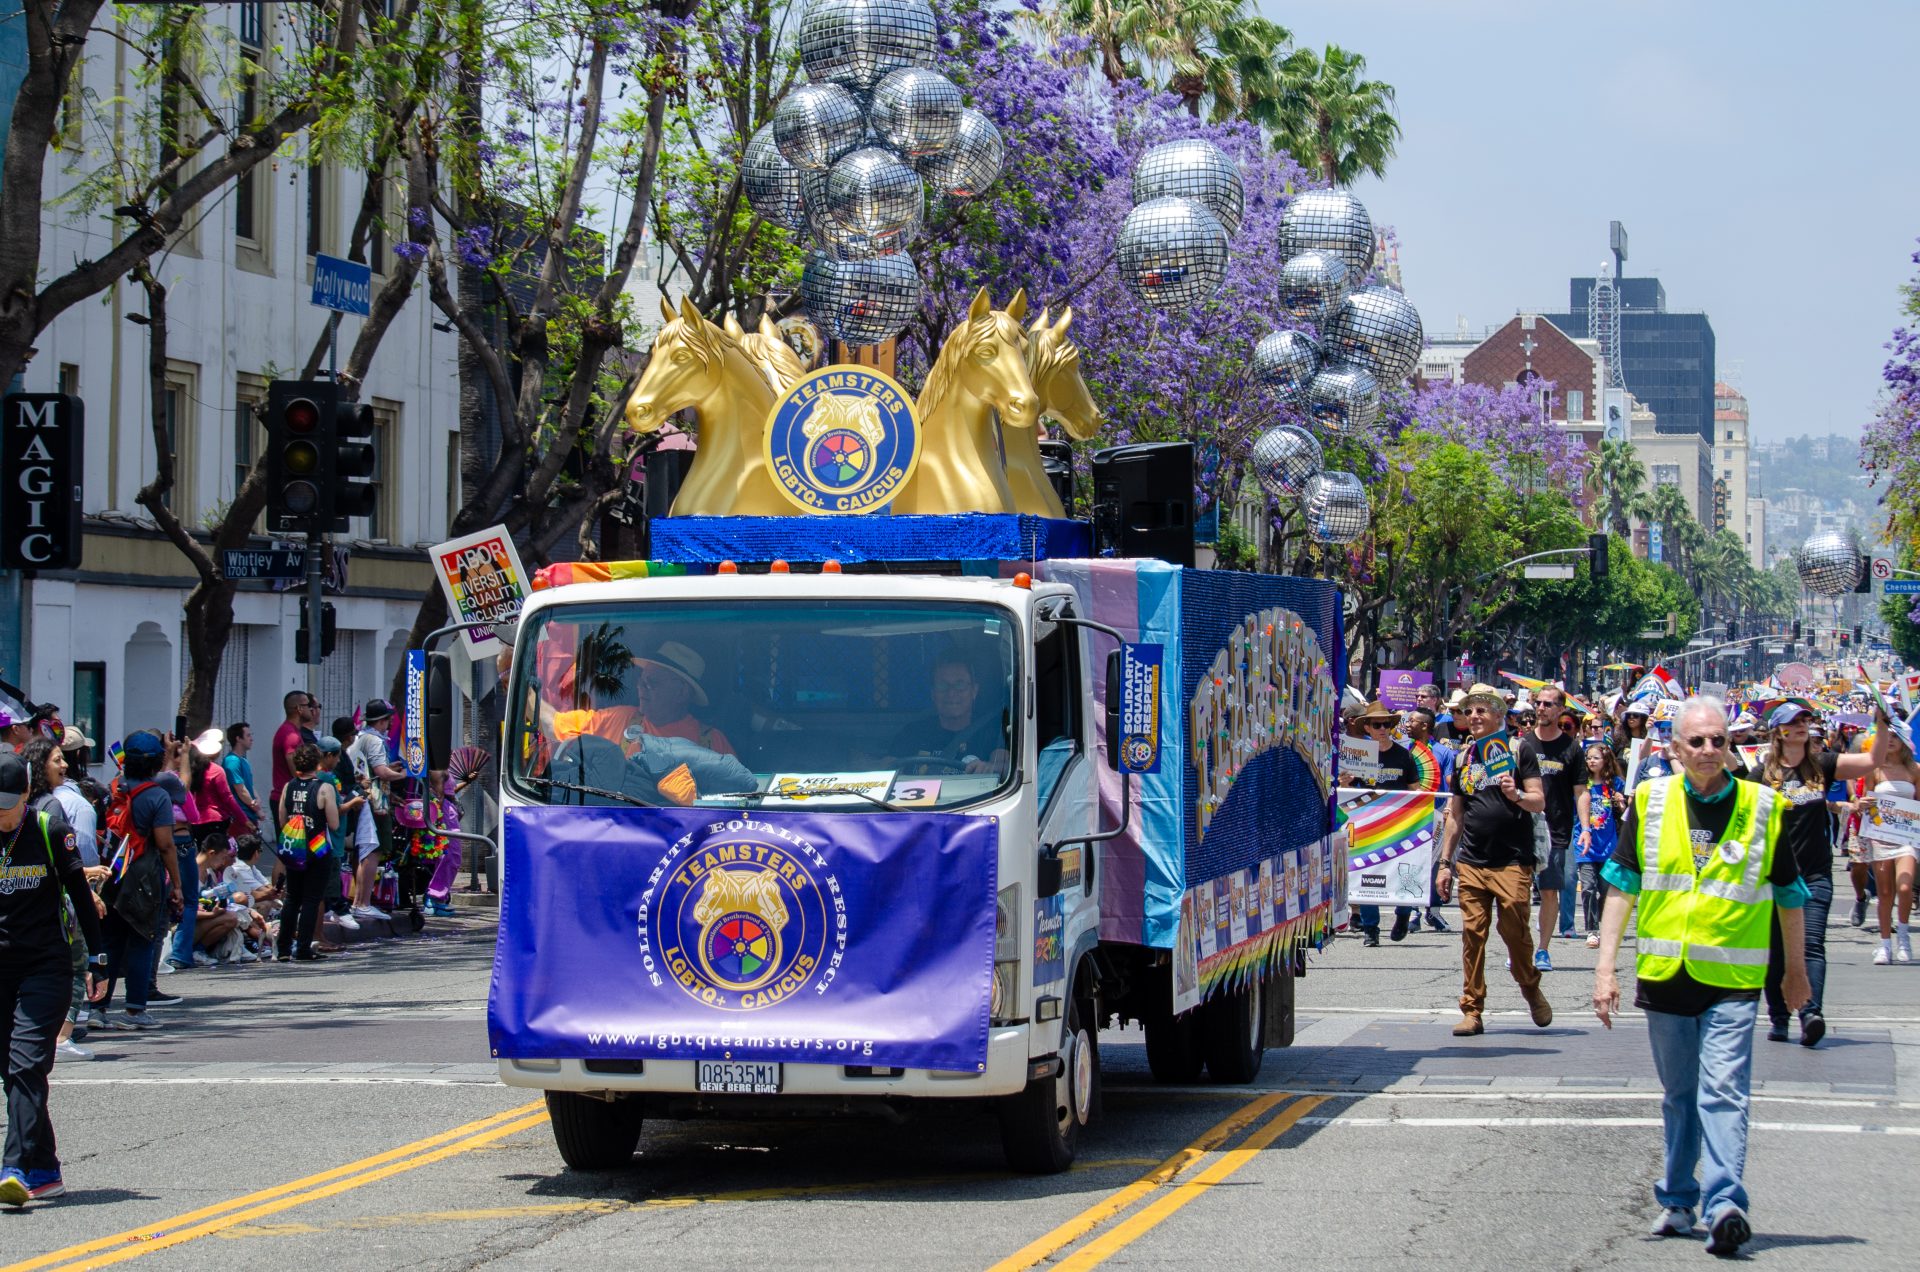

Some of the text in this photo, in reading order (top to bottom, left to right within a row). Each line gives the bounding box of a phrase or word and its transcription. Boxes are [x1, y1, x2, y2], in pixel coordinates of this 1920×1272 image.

[314, 267, 369, 304] Hollywood
[790, 374, 903, 414] TEAMSTERS
[16, 401, 60, 562] MAGIC
[774, 455, 903, 510] LGBTQ+ CAUCUS
[228, 551, 301, 570] Whitley Av
[228, 567, 258, 576] 1700 N
[443, 541, 507, 576] LABOR
[453, 568, 515, 598] DIVERSITY
[460, 583, 519, 611] EQUALITY
[464, 597, 524, 623] INCLUSION
[1124, 645, 1135, 734] SOLIDARITY
[1133, 660, 1143, 734] EQUALITY
[1143, 664, 1153, 734] RESPECT
[1880, 800, 1896, 808] KEEP
[676, 844, 807, 891] TEAMSTERS
[638, 820, 847, 996] SOLIDARITY EQUALITY RESPECT
[708, 920, 723, 961] International
[722, 913, 761, 925] Brotherhood
[665, 946, 815, 1009] LGBTQ+ CAUCUS
[587, 1031, 874, 1056] www.lgbtqteamsters.org
[700, 1082, 777, 1094] GENE BERG GMC
[702, 1063, 775, 1084] 08535M1
